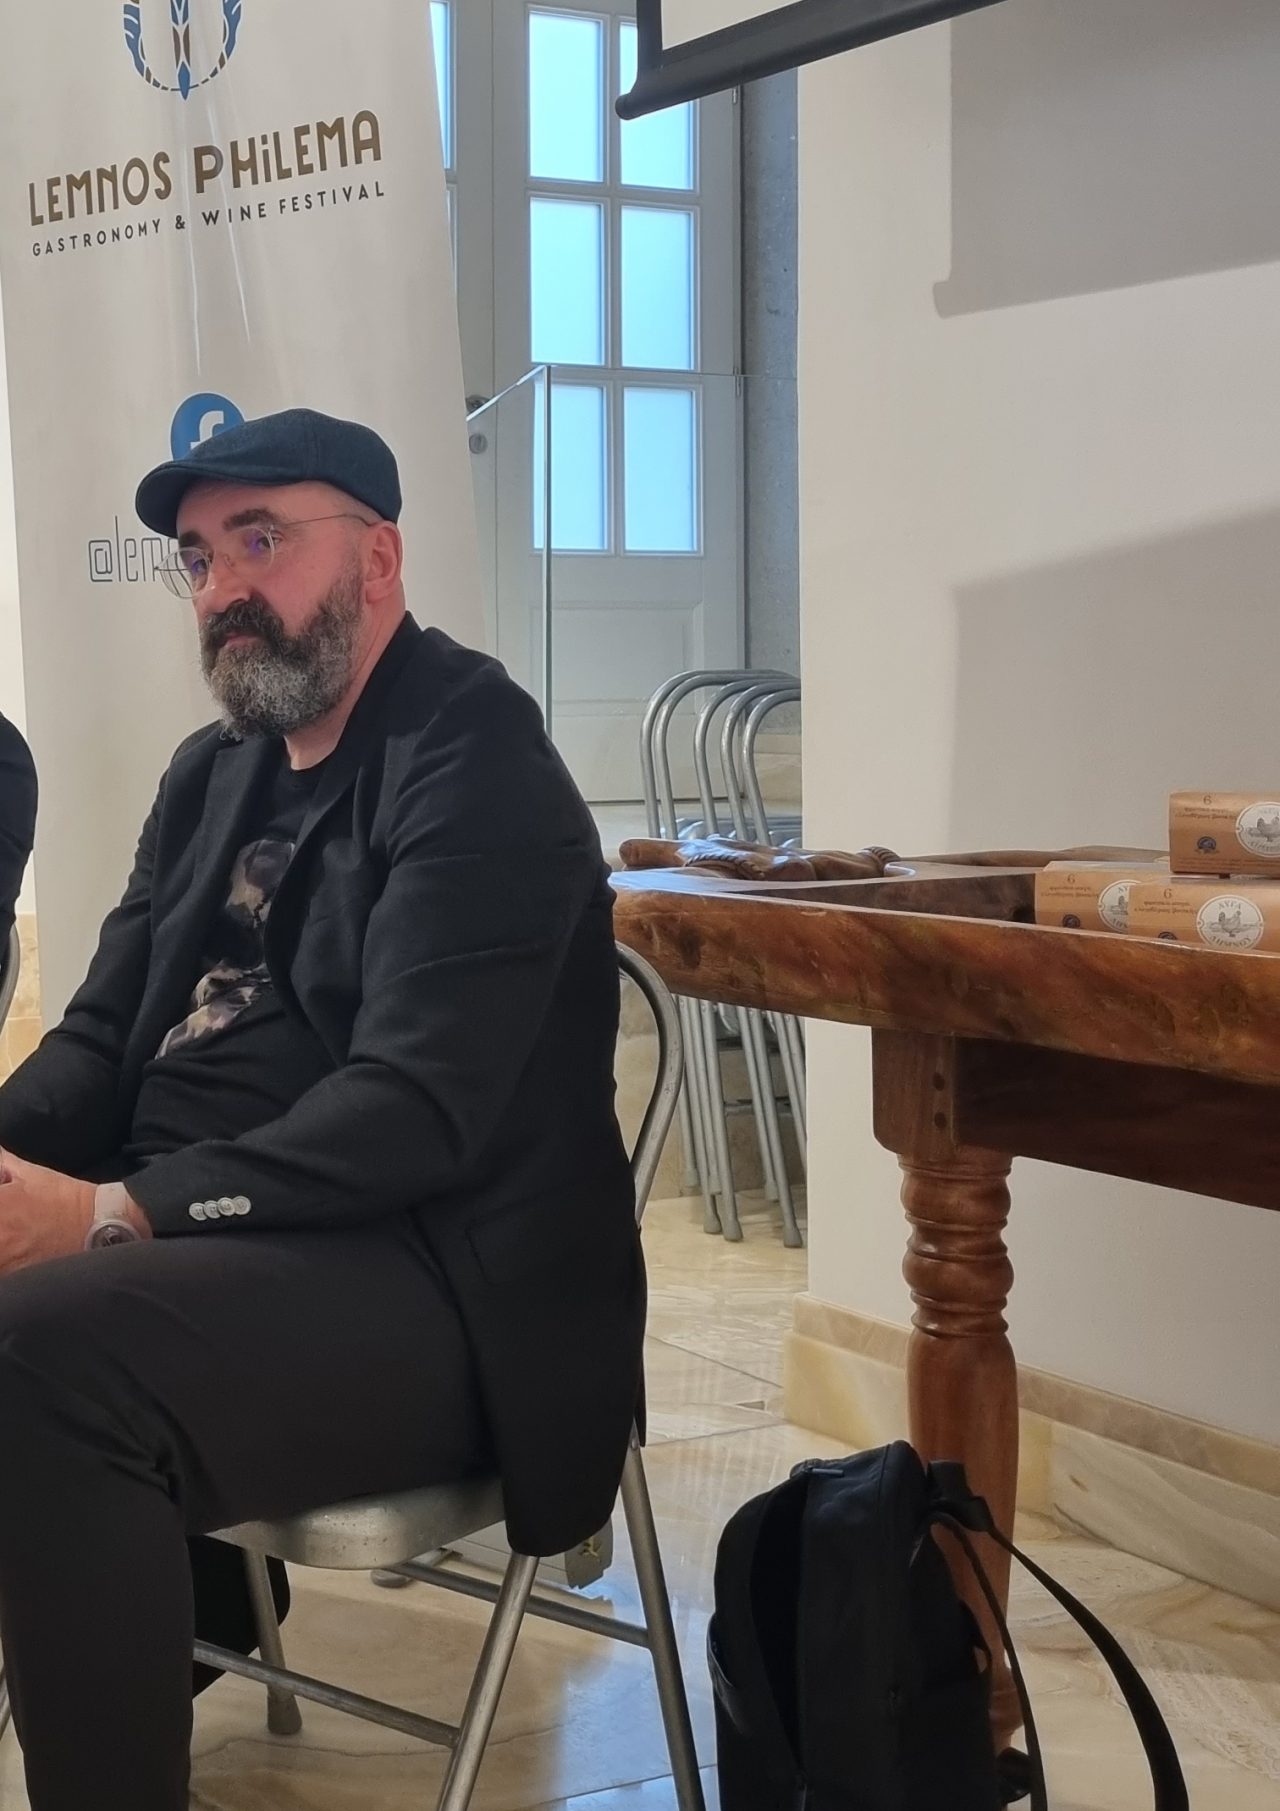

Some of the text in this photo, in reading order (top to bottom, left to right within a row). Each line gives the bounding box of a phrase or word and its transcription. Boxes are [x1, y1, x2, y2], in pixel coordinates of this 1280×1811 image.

[29, 151, 172, 226] LEMNOS
[32, 181, 384, 256] GASTRONOMY & WINE FESTIVAL
[1203, 795, 1212, 805] 6
[1067, 873, 1076, 884] 6
[1163, 888, 1173, 899] 6
